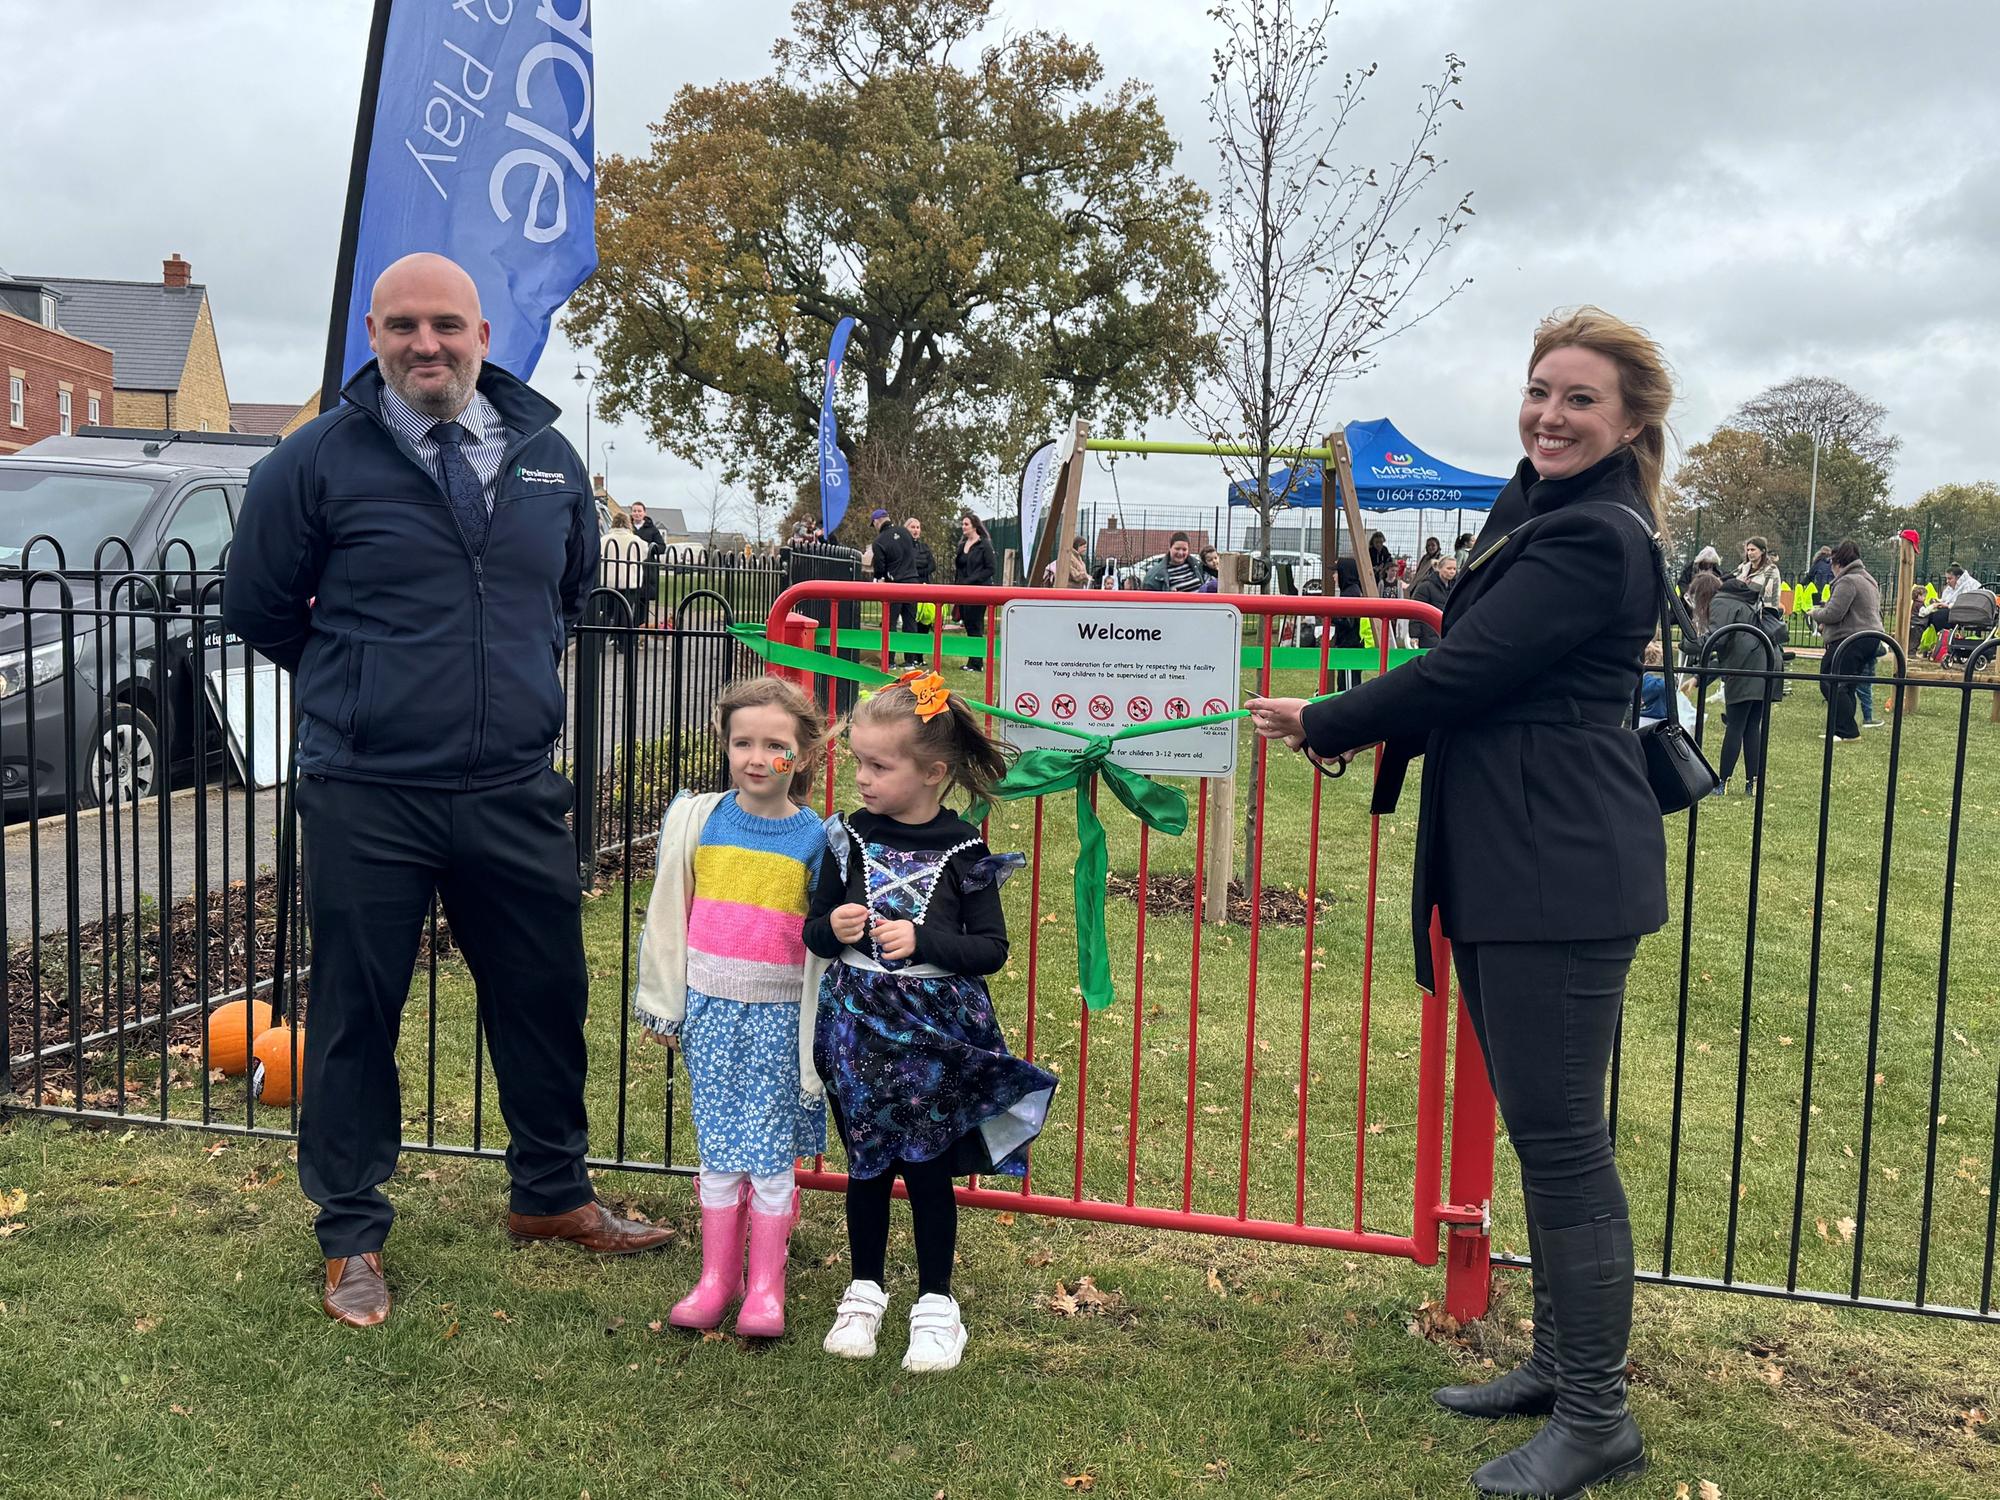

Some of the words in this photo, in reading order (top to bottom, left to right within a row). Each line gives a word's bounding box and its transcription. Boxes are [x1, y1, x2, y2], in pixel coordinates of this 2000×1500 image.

[405, 39, 494, 201] Play
[521, 468, 564, 479] Persimmon
[1371, 466, 1438, 477] Miracle
[1376, 489, 1414, 501] 01604
[1417, 489, 1462, 501] 658240
[1077, 623, 1162, 641] Welcome
[1024, 659, 1042, 667] Please
[1061, 660, 1100, 669] consideration
[1102, 661, 1112, 669] for
[1136, 662, 1144, 671] by
[1145, 663, 1178, 672] respecting
[1193, 664, 1216, 673] facility
[1053, 670, 1070, 678] Young
[1117, 672, 1148, 680] supervised
[1129, 749, 1153, 757] children
[1156, 750, 1171, 758] 3-12
